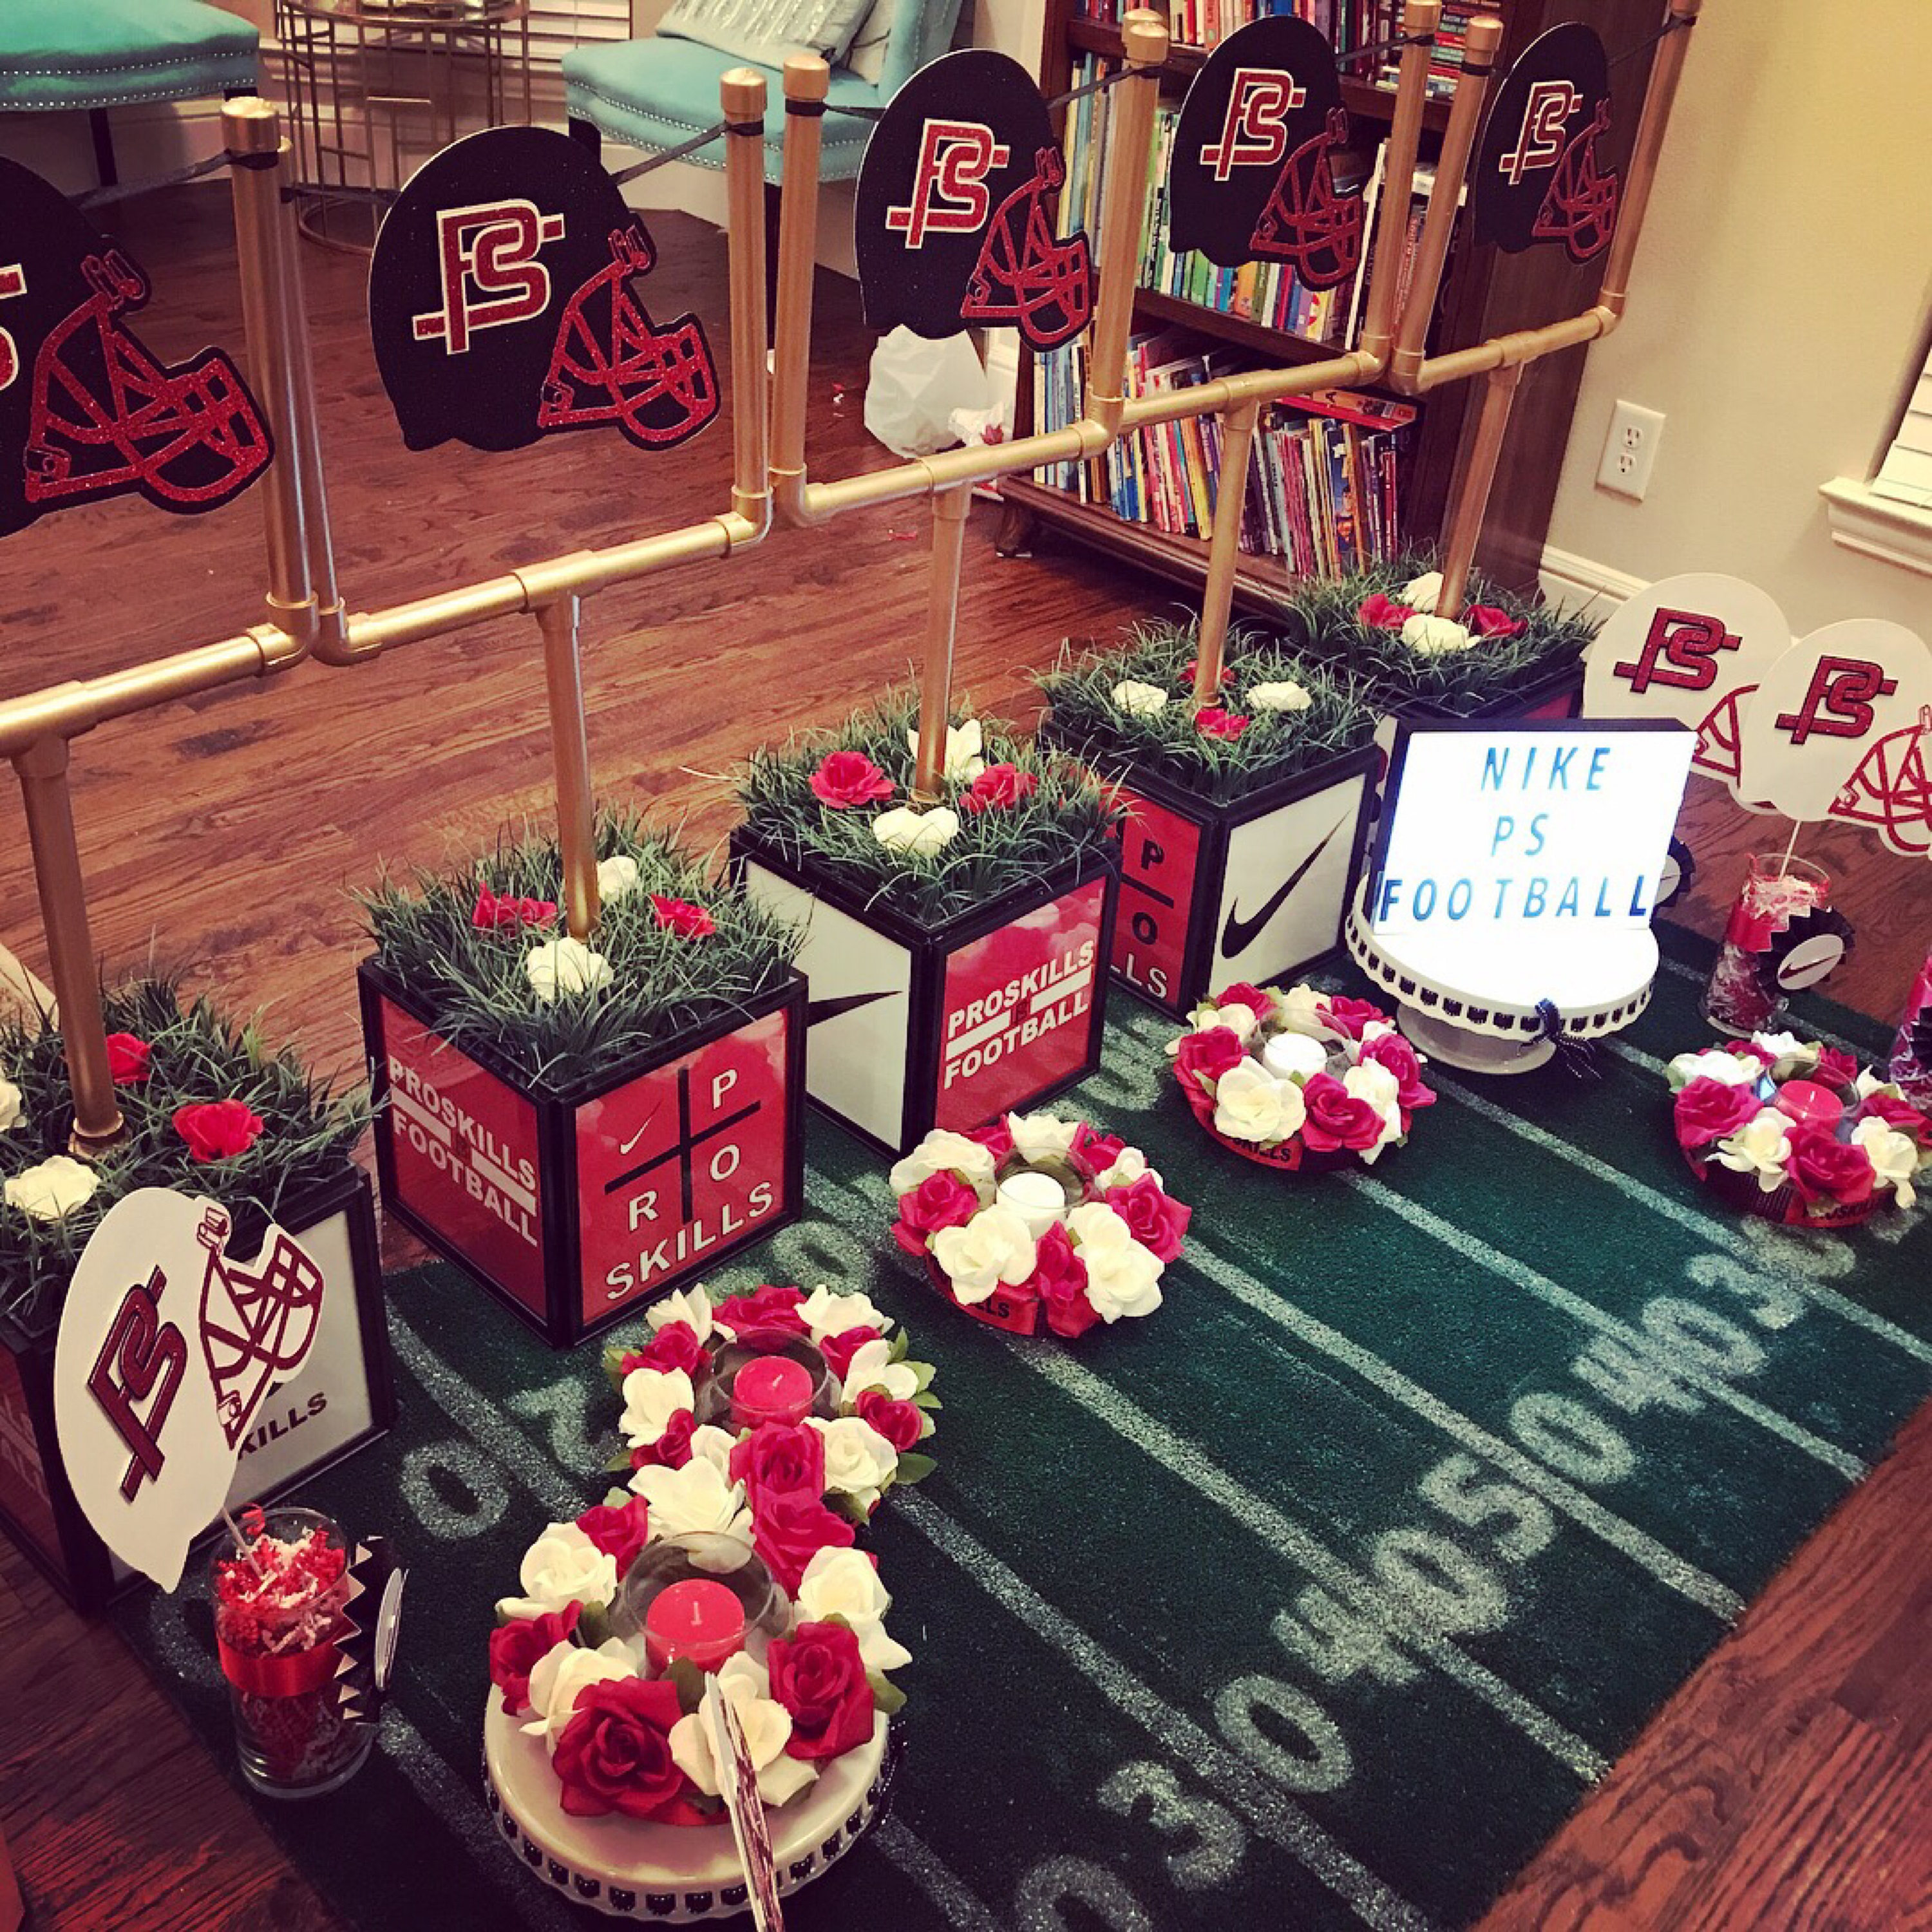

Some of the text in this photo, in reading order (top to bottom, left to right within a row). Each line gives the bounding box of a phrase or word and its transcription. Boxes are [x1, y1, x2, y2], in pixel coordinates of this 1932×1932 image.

[1200, 68, 1306, 182] PS
[1499, 80, 1583, 185] PS
[886, 118, 1010, 249] PS
[412, 198, 565, 355] PS
[1613, 607, 1743, 694] PS
[1774, 654, 1899, 746] PS
[1481, 746, 1611, 791] NIKE
[1141, 838, 1164, 870] P
[1492, 813, 1549, 857] PS
[1132, 912, 1158, 945] O
[1378, 874, 1647, 922] FOOTBALL
[948, 940, 1094, 1039] PROSKILLS
[944, 990, 1088, 1090] FOOTBALL
[388, 1056, 536, 1191] PROSKILLS
[712, 1068, 738, 1110] P
[392, 1108, 538, 1247] FOOTBALL
[629, 1144, 740, 1231] R O
[605, 1181, 773, 1301] SKILLS
[86, 1265, 188, 1502] PS
[238, 1392, 327, 1461] KILLS
